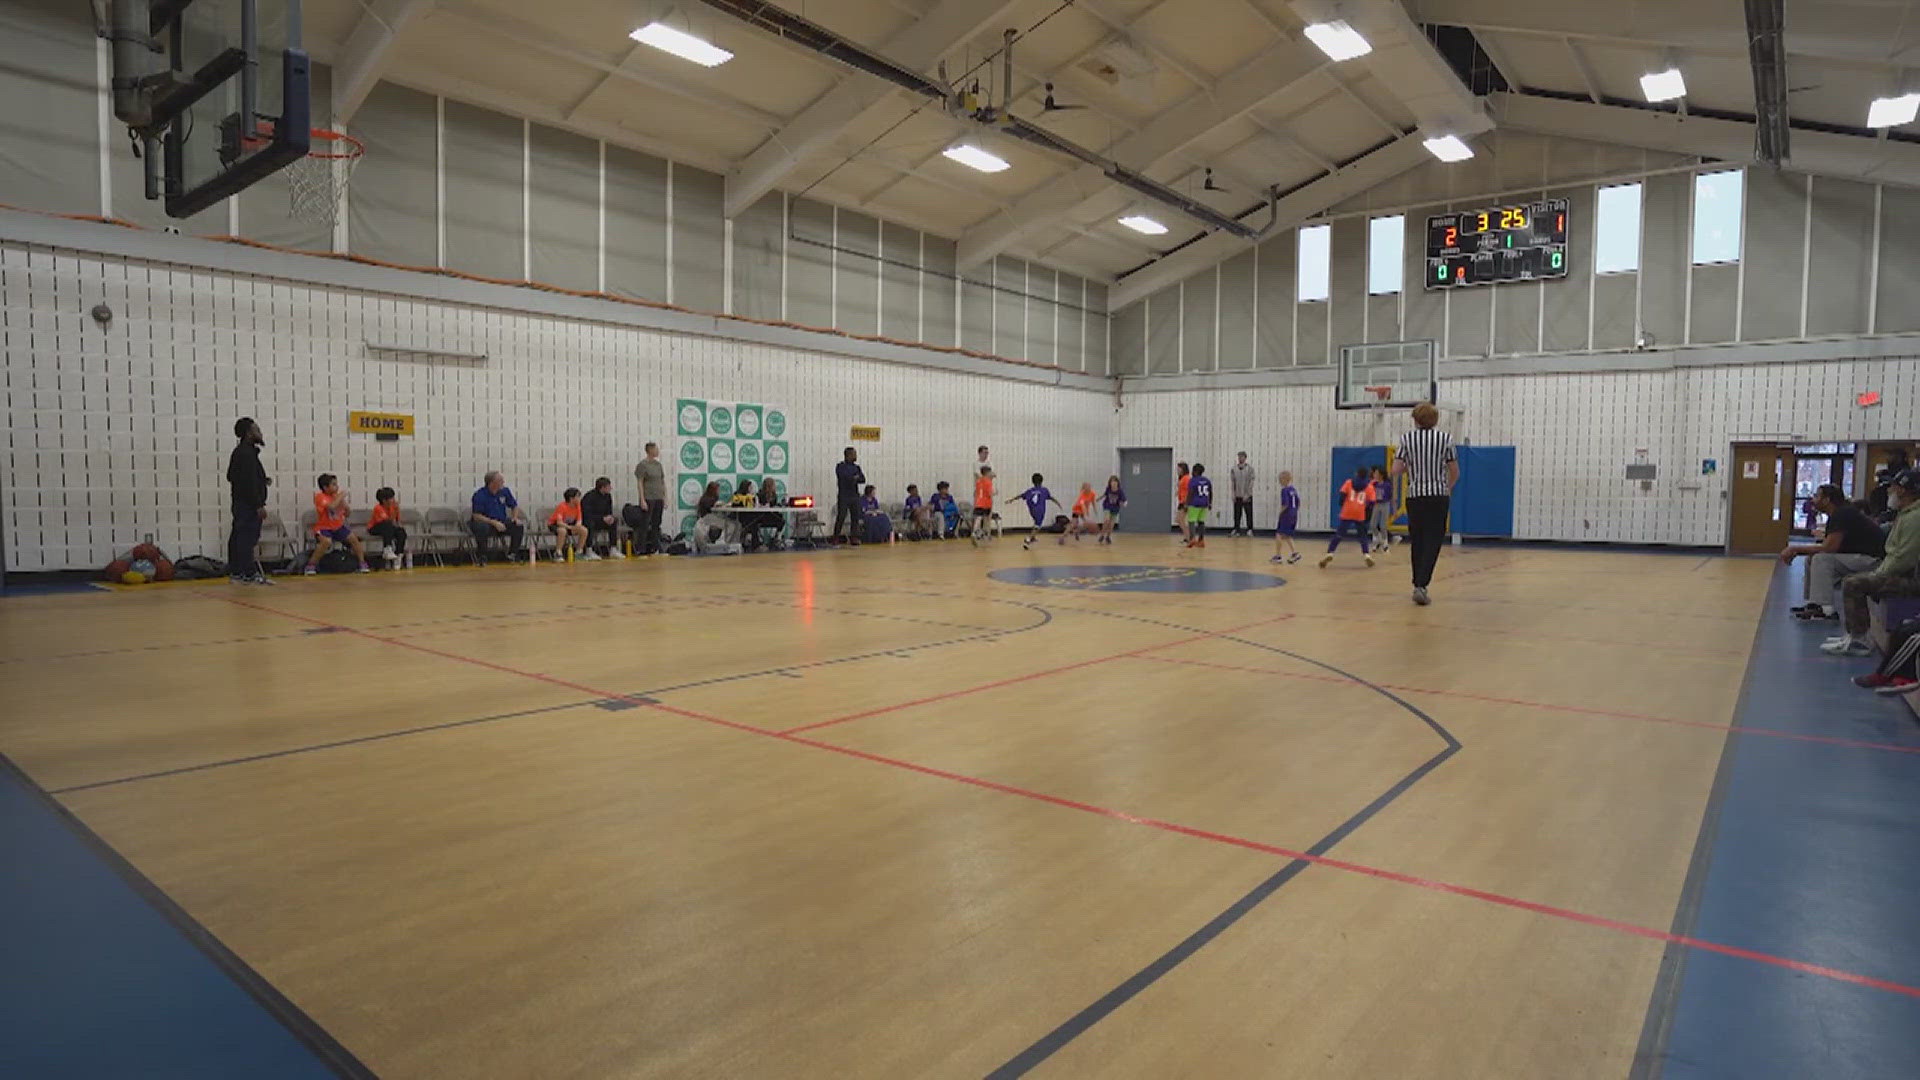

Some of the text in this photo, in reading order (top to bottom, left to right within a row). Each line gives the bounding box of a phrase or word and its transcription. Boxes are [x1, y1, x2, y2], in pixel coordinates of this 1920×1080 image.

[1477, 208, 1525, 232] 3 25
[1558, 214, 1564, 232] 1
[1445, 227, 1457, 247] 2
[1506, 234, 1512, 248] 1
[1552, 252, 1562, 268] 0
[1438, 264, 1447, 280] 0
[360, 416, 404, 430] HOME
